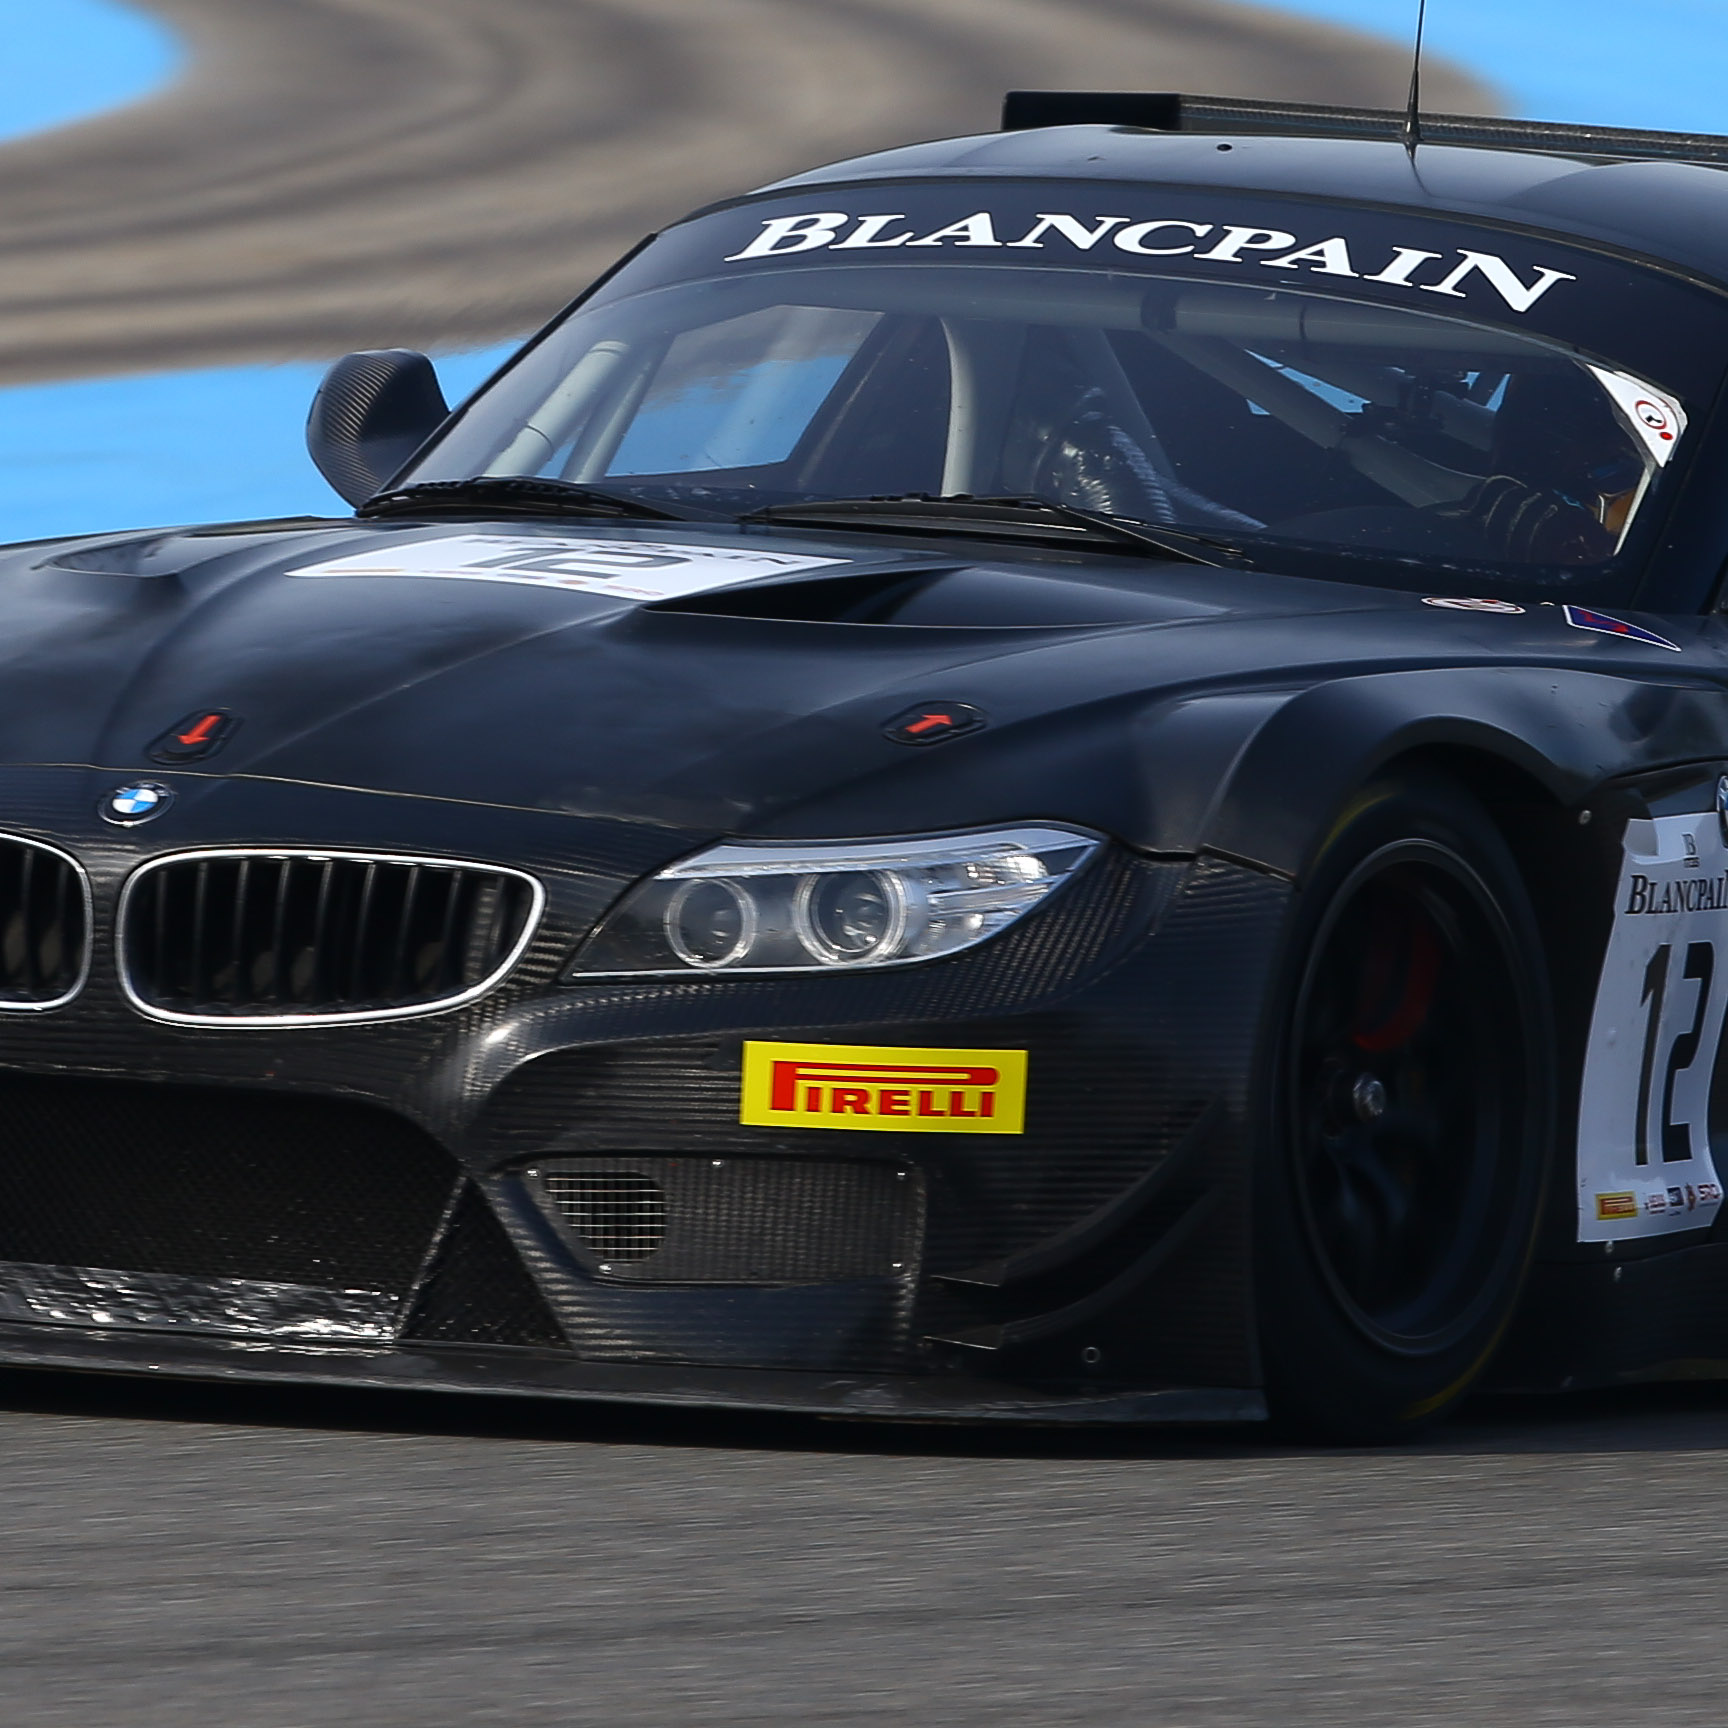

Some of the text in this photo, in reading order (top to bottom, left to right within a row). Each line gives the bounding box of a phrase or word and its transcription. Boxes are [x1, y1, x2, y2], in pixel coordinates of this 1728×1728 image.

[724, 210, 1577, 313] BLANCPAIN
[459, 547, 693, 580] 12
[769, 1060, 1001, 1118] PIRELLI
[1634, 940, 1715, 1167] 12
